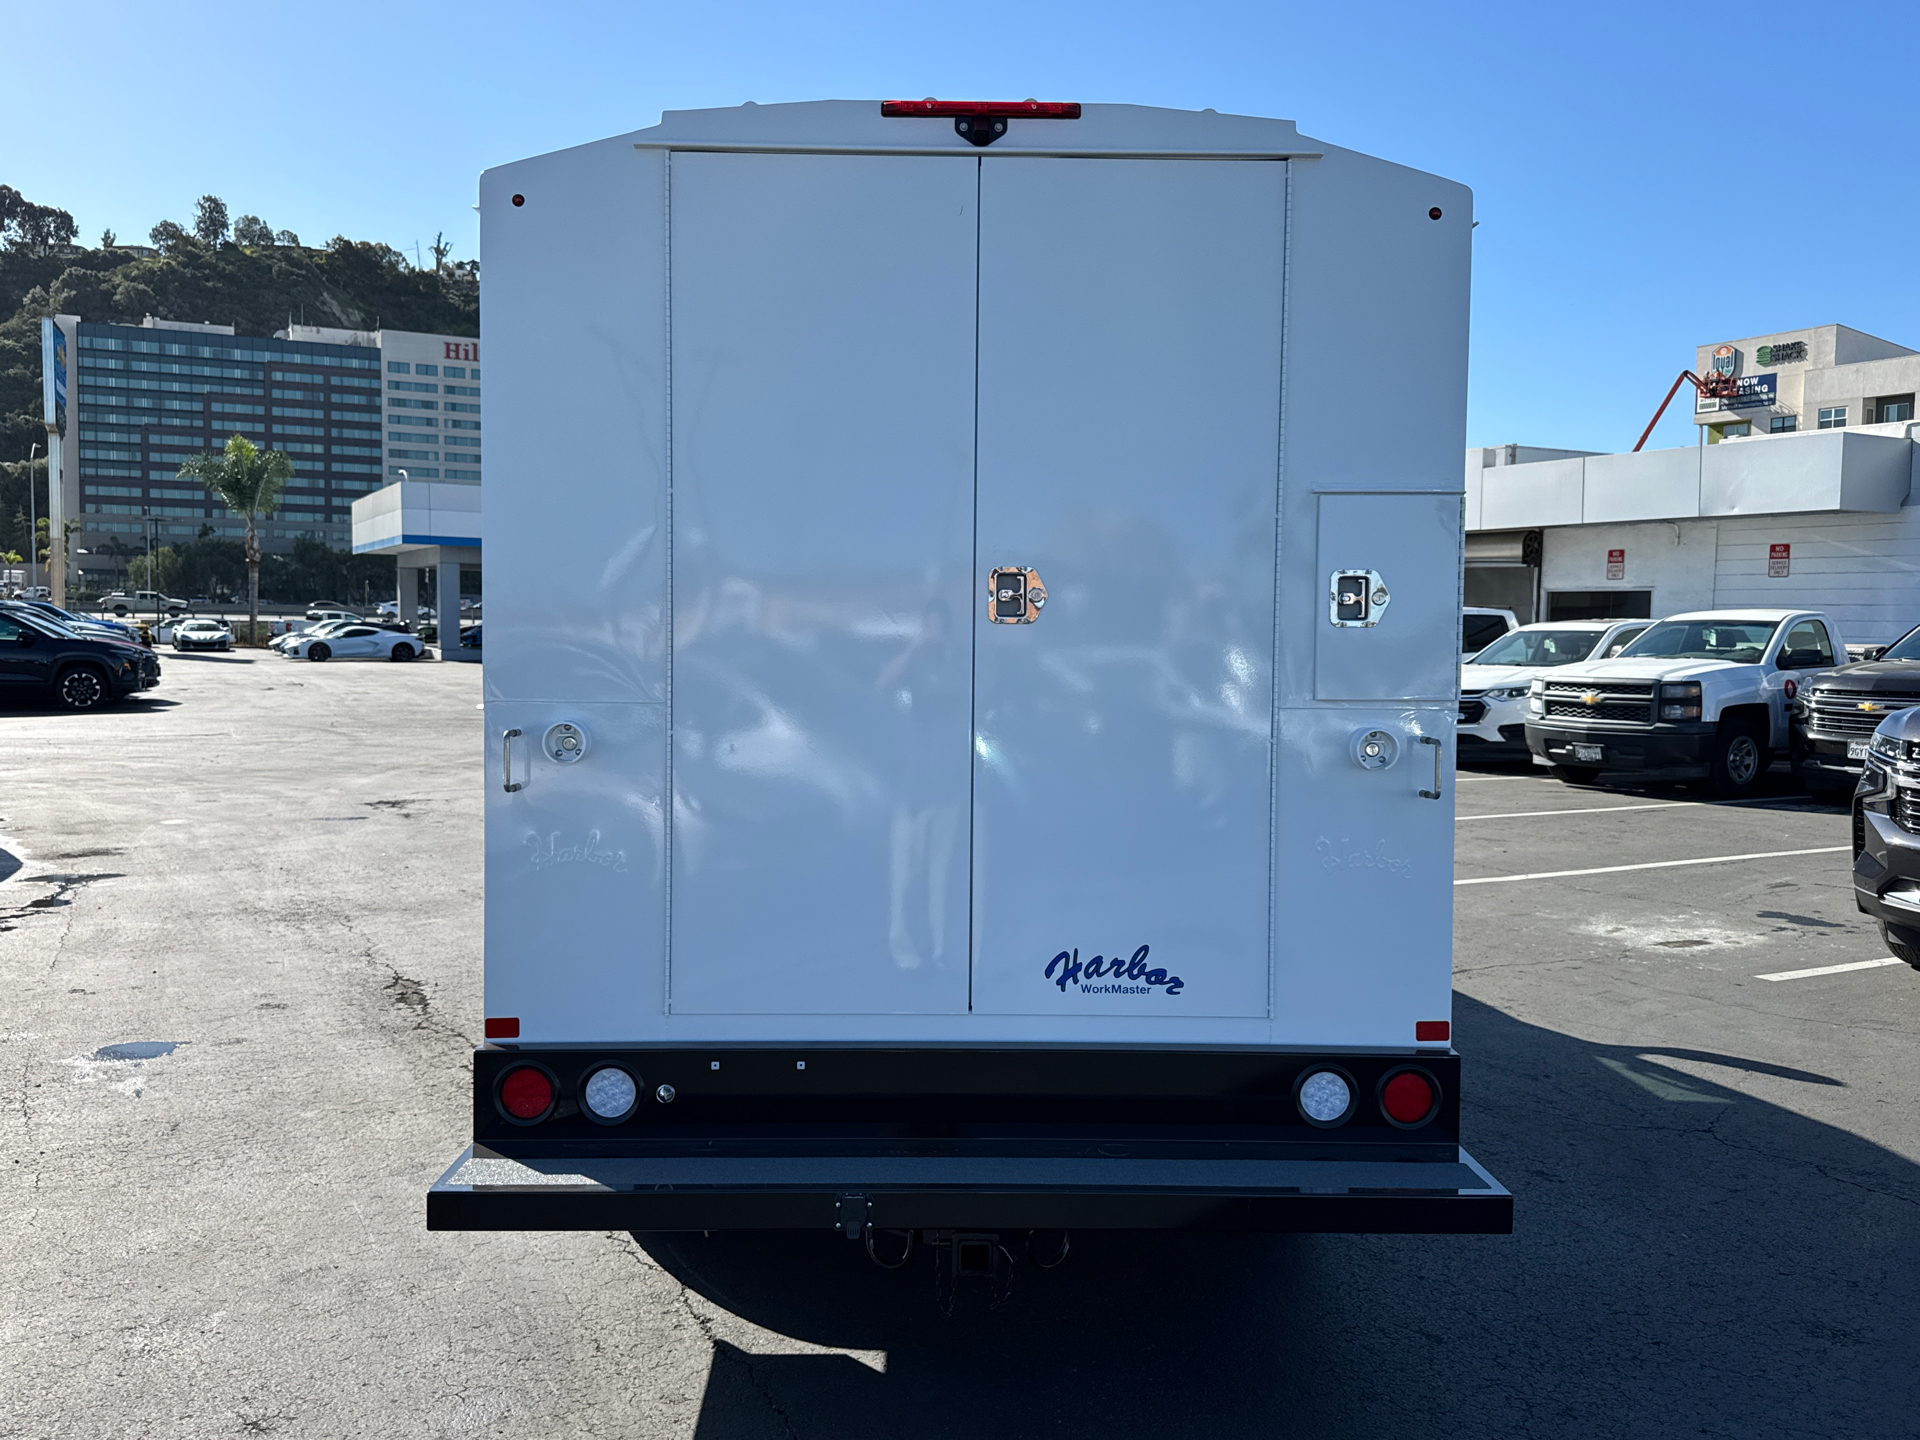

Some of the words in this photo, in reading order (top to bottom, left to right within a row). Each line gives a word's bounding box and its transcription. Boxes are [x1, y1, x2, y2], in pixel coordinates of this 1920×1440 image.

[443, 342, 480, 362] Hil
[1773, 341, 1803, 352] SHAKE
[1772, 350, 1803, 361] SHACK
[1713, 350, 1734, 374] loyal
[1737, 377, 1759, 387] NOW
[1850, 747, 1868, 756] 9GYT
[1045, 944, 1184, 995] Harbor
[1080, 984, 1152, 995] WorkMaster
